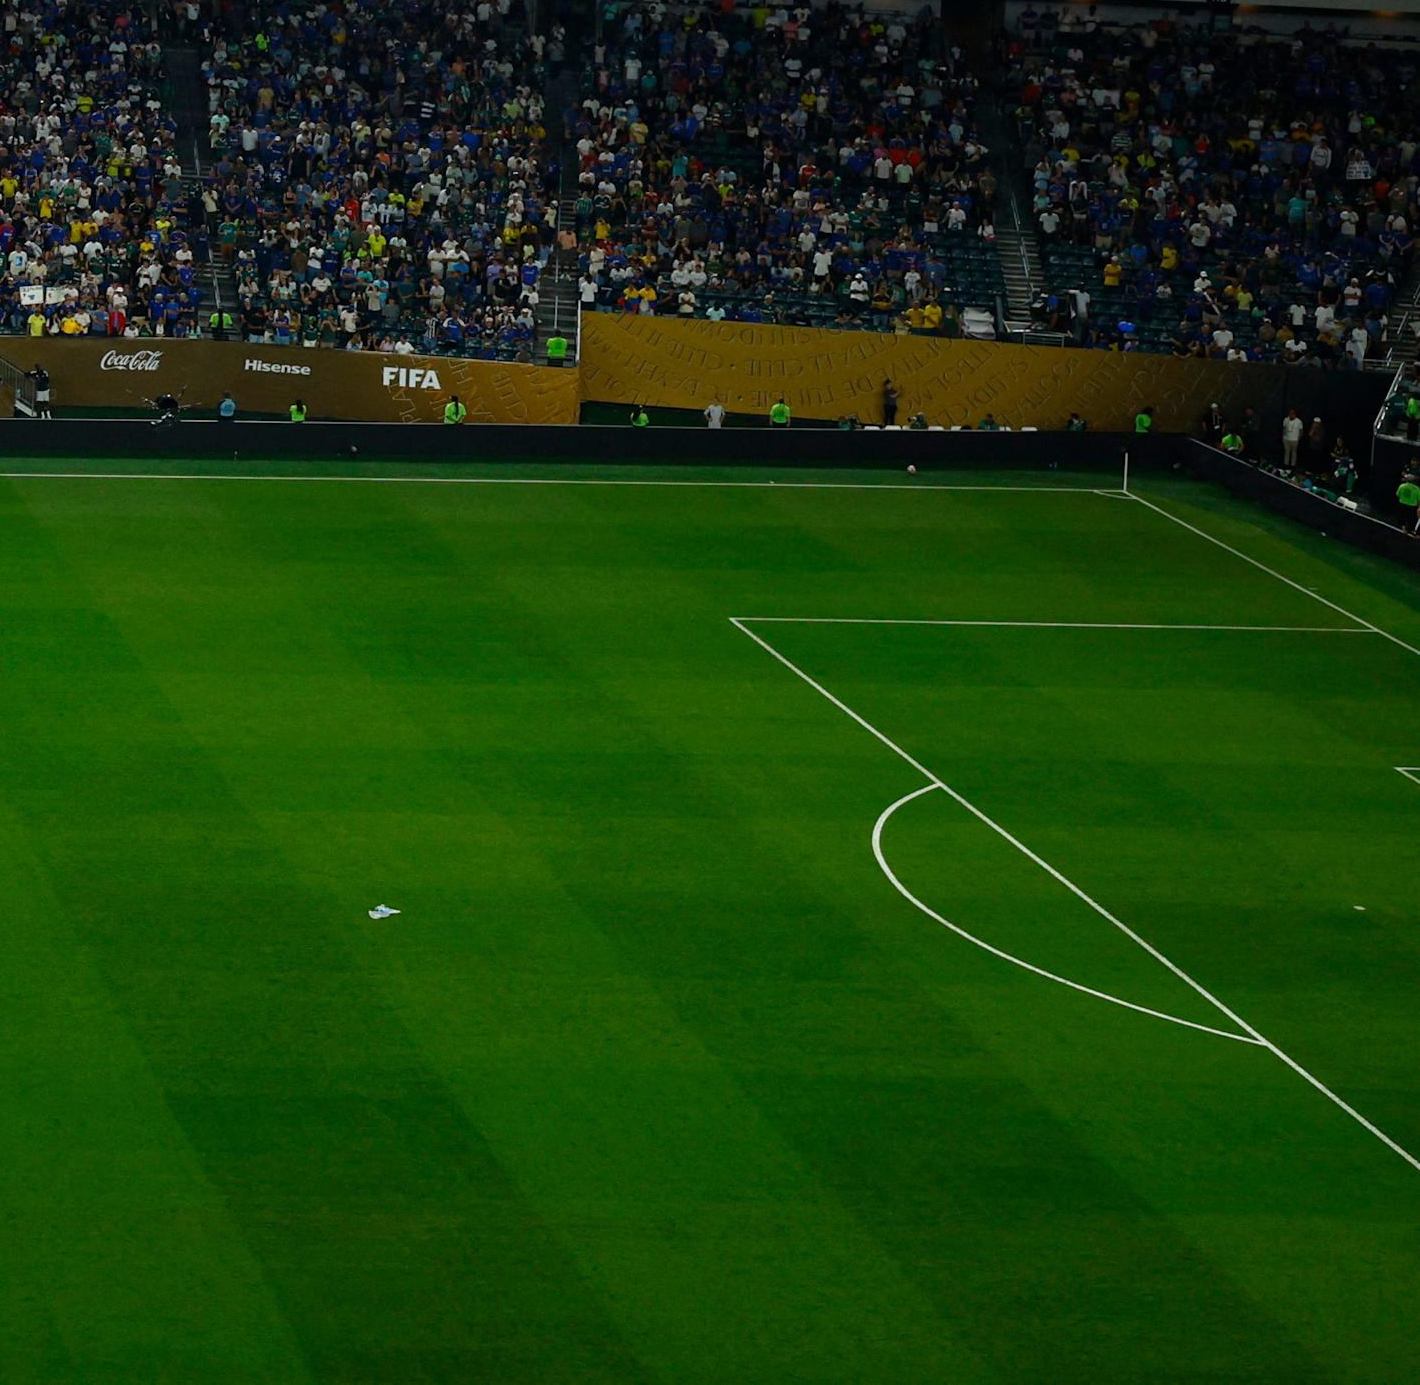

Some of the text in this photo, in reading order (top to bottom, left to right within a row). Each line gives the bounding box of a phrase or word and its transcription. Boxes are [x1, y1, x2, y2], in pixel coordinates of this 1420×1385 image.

[101, 350, 164, 371] Coca-Cola
[244, 359, 312, 376] Hisense
[383, 366, 441, 390] FIFA
